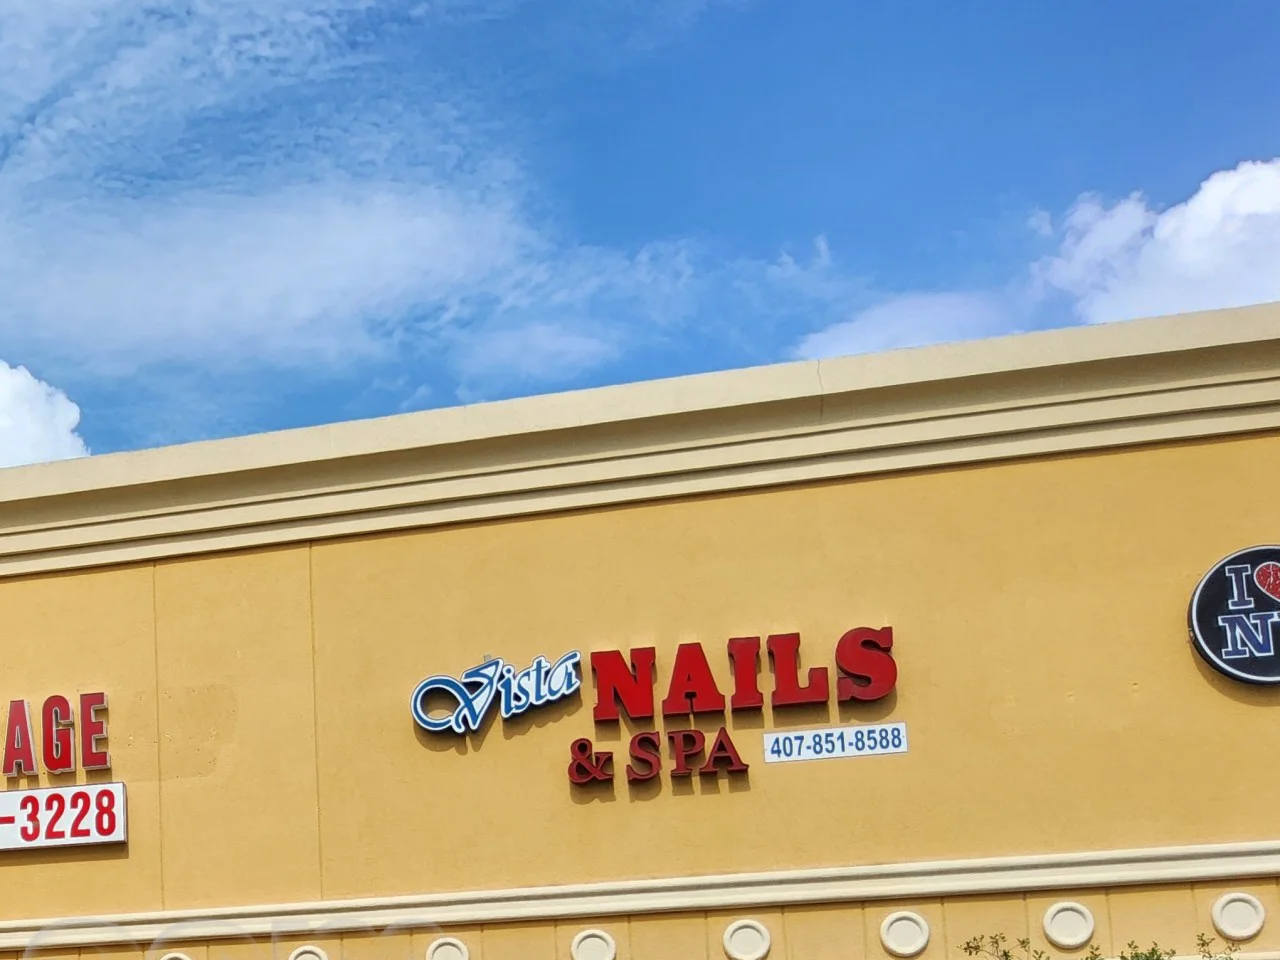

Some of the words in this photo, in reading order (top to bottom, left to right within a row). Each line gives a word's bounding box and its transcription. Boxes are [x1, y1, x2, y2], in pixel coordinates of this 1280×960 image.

[1225, 564, 1255, 610] I
[1217, 611, 1280, 660] N
[410, 650, 582, 735] Vista
[589, 626, 898, 724] NAILS
[567, 738, 614, 785] &
[626, 726, 750, 781] SPA
[768, 726, 904, 759] 407-851-8588
